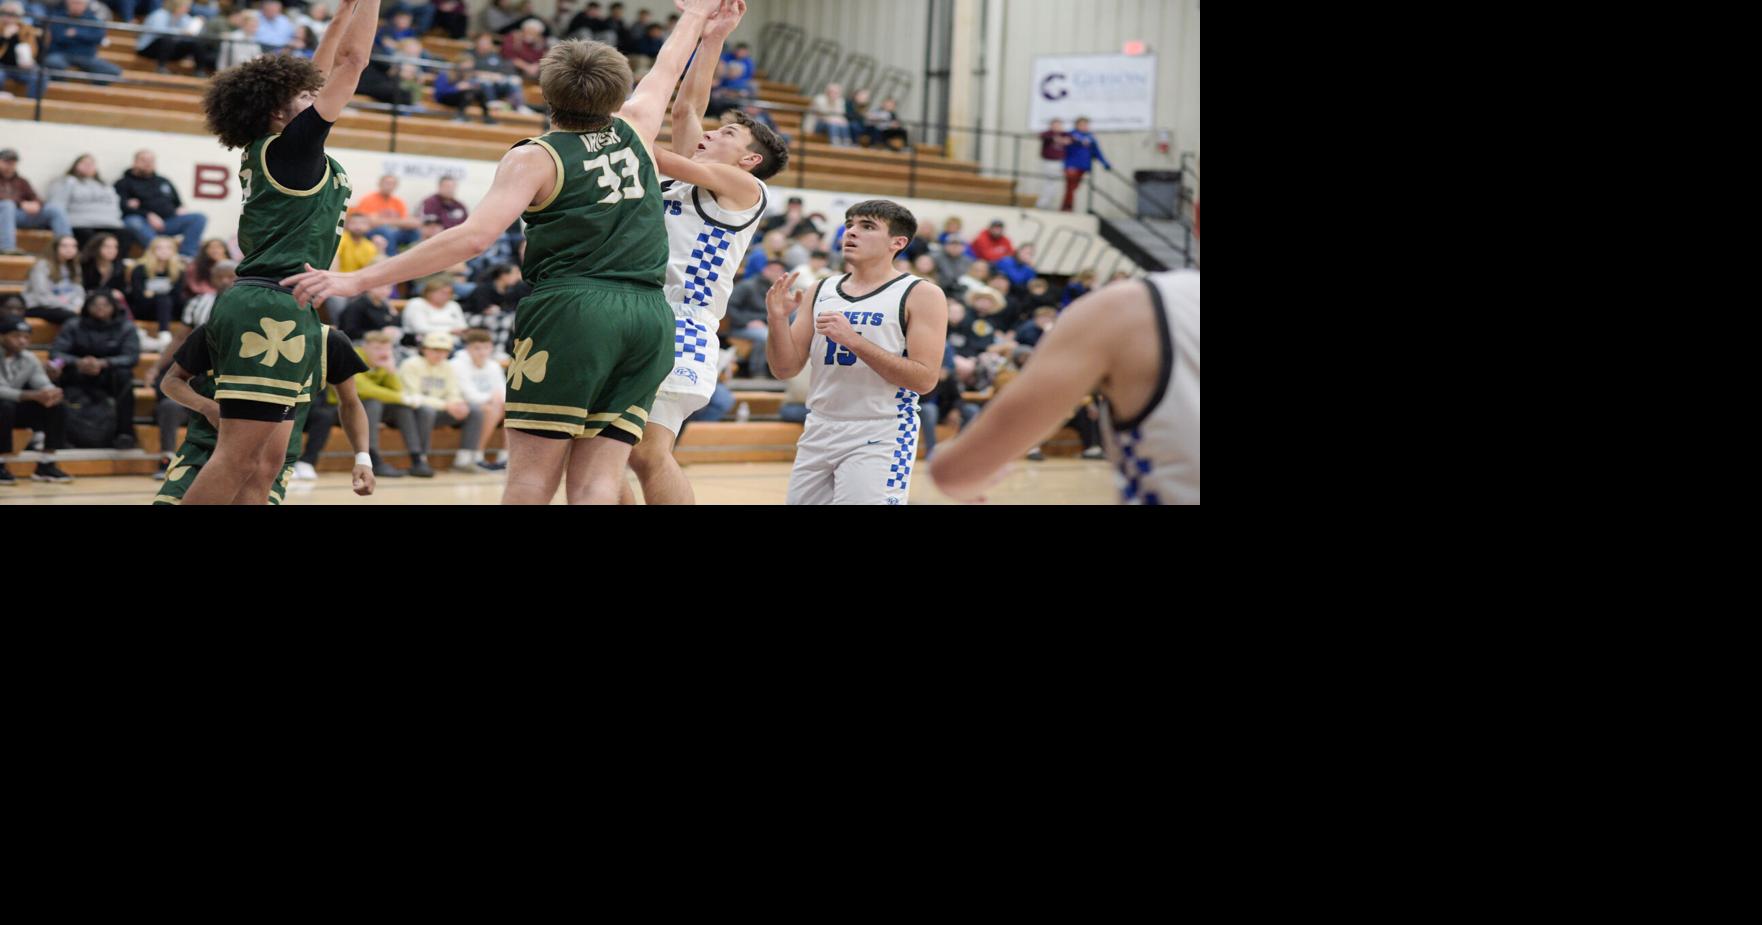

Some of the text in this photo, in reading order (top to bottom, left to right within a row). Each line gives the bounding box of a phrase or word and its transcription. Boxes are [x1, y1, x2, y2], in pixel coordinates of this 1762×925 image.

[194, 164, 229, 199] B
[583, 147, 645, 204] 33
[818, 311, 884, 326] ETS
